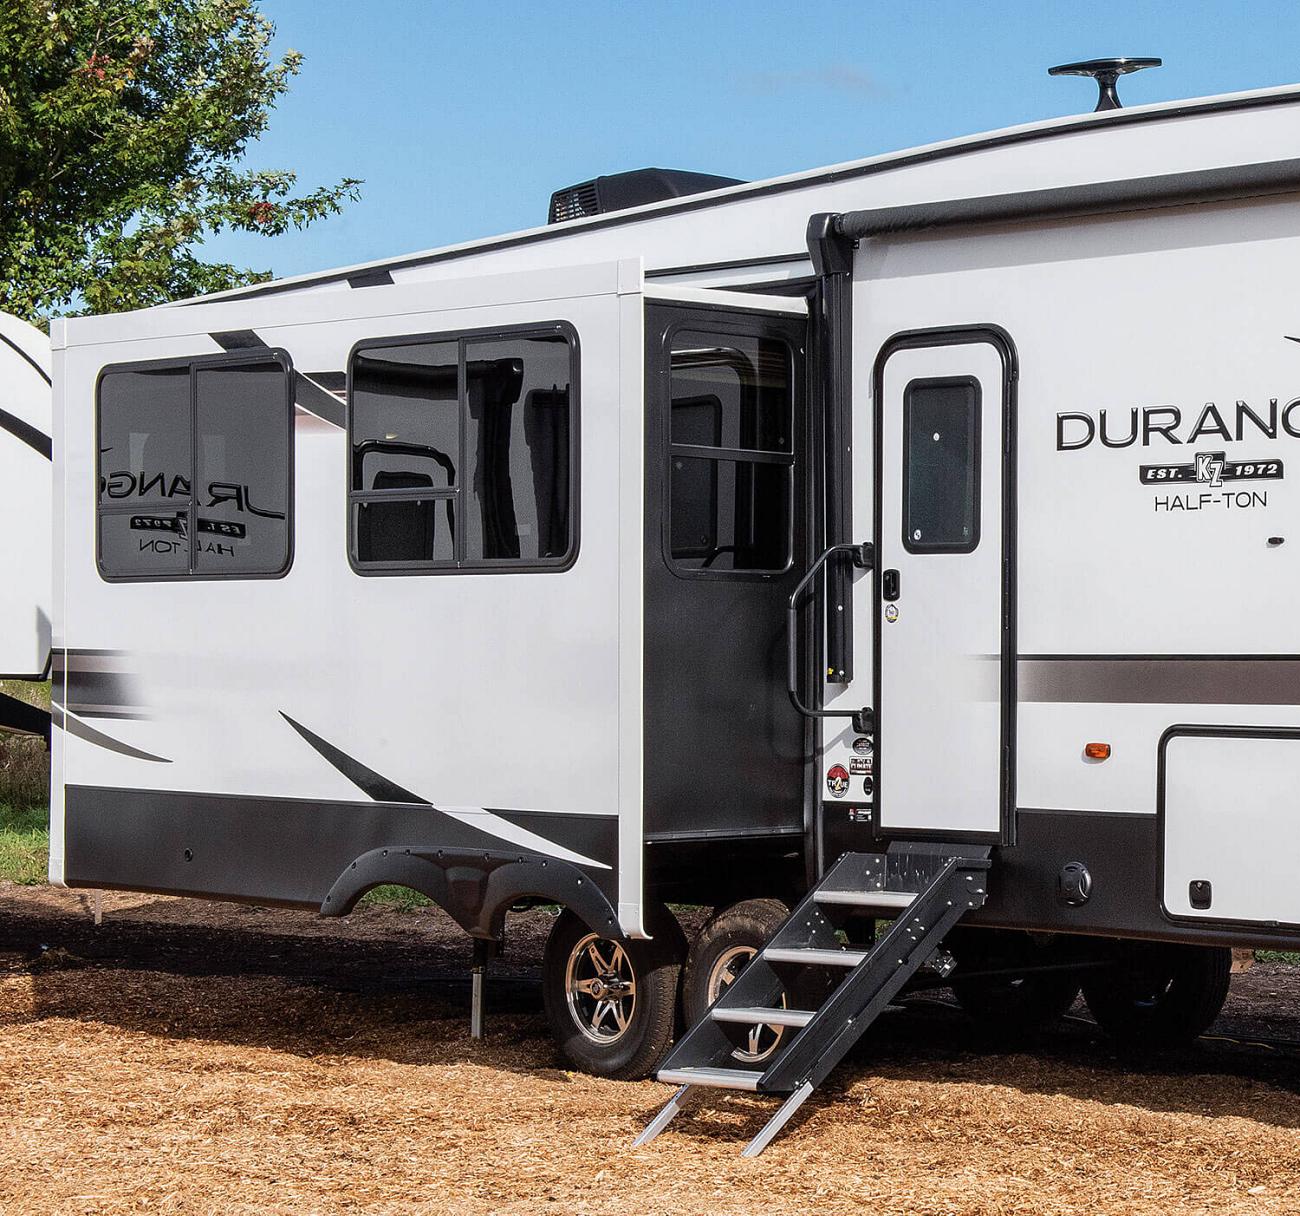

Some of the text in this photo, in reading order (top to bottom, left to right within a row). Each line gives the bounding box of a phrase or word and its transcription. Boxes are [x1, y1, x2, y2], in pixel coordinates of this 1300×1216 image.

[1146, 453, 1278, 488] EST. KZ 1972
[1155, 491, 1267, 511] HALF-TON
